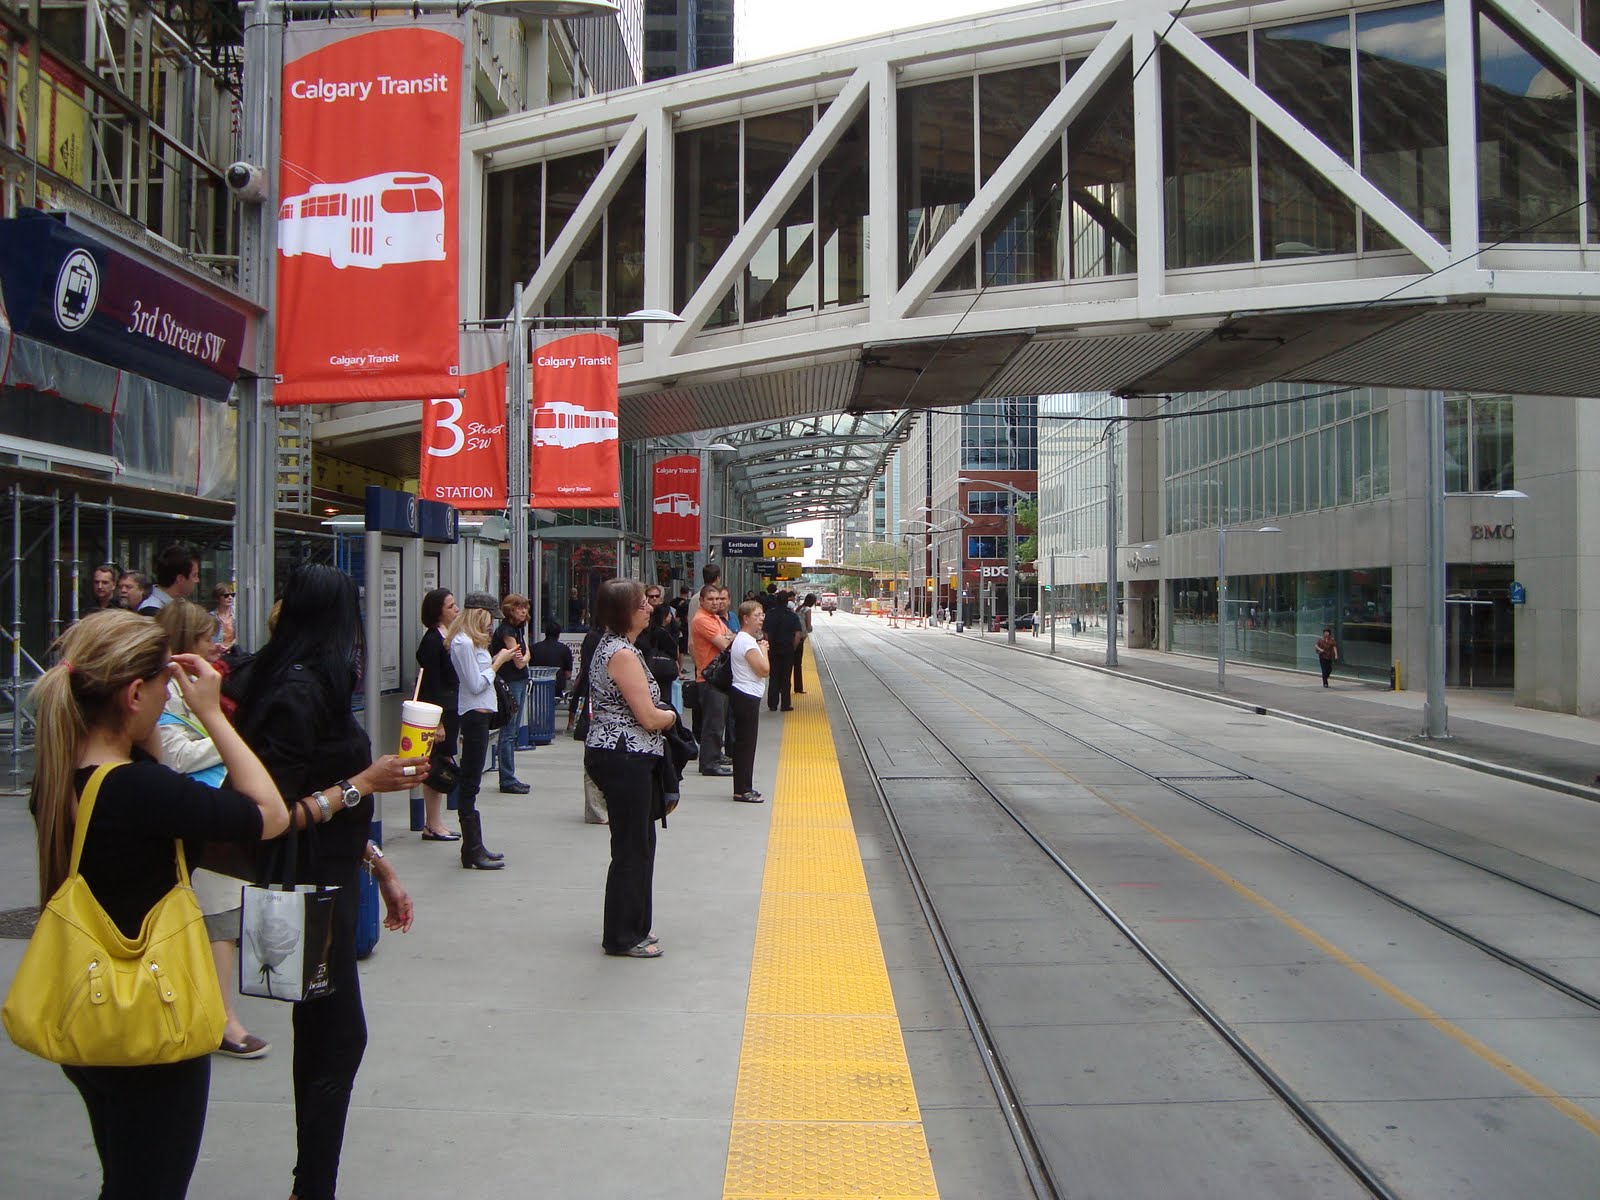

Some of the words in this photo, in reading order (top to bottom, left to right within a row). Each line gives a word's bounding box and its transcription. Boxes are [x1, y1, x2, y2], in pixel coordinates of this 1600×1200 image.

[290, 78, 373, 103] Calgary
[377, 73, 448, 95] Transit
[127, 300, 160, 338] 3rd
[159, 313, 201, 356] Street
[201, 332, 226, 363] SW
[329, 355, 366, 366] Calgary
[367, 353, 400, 363] Transit
[537, 356, 576, 369] Calgary
[577, 355, 612, 366] Transit
[427, 398, 465, 457] 3
[467, 421, 505, 436] Street
[466, 437, 492, 451] SW
[656, 467, 678, 475] Calgary
[435, 486, 493, 498] STATION
[1471, 524, 1515, 540] BMO
[983, 566, 1009, 578] BDC
